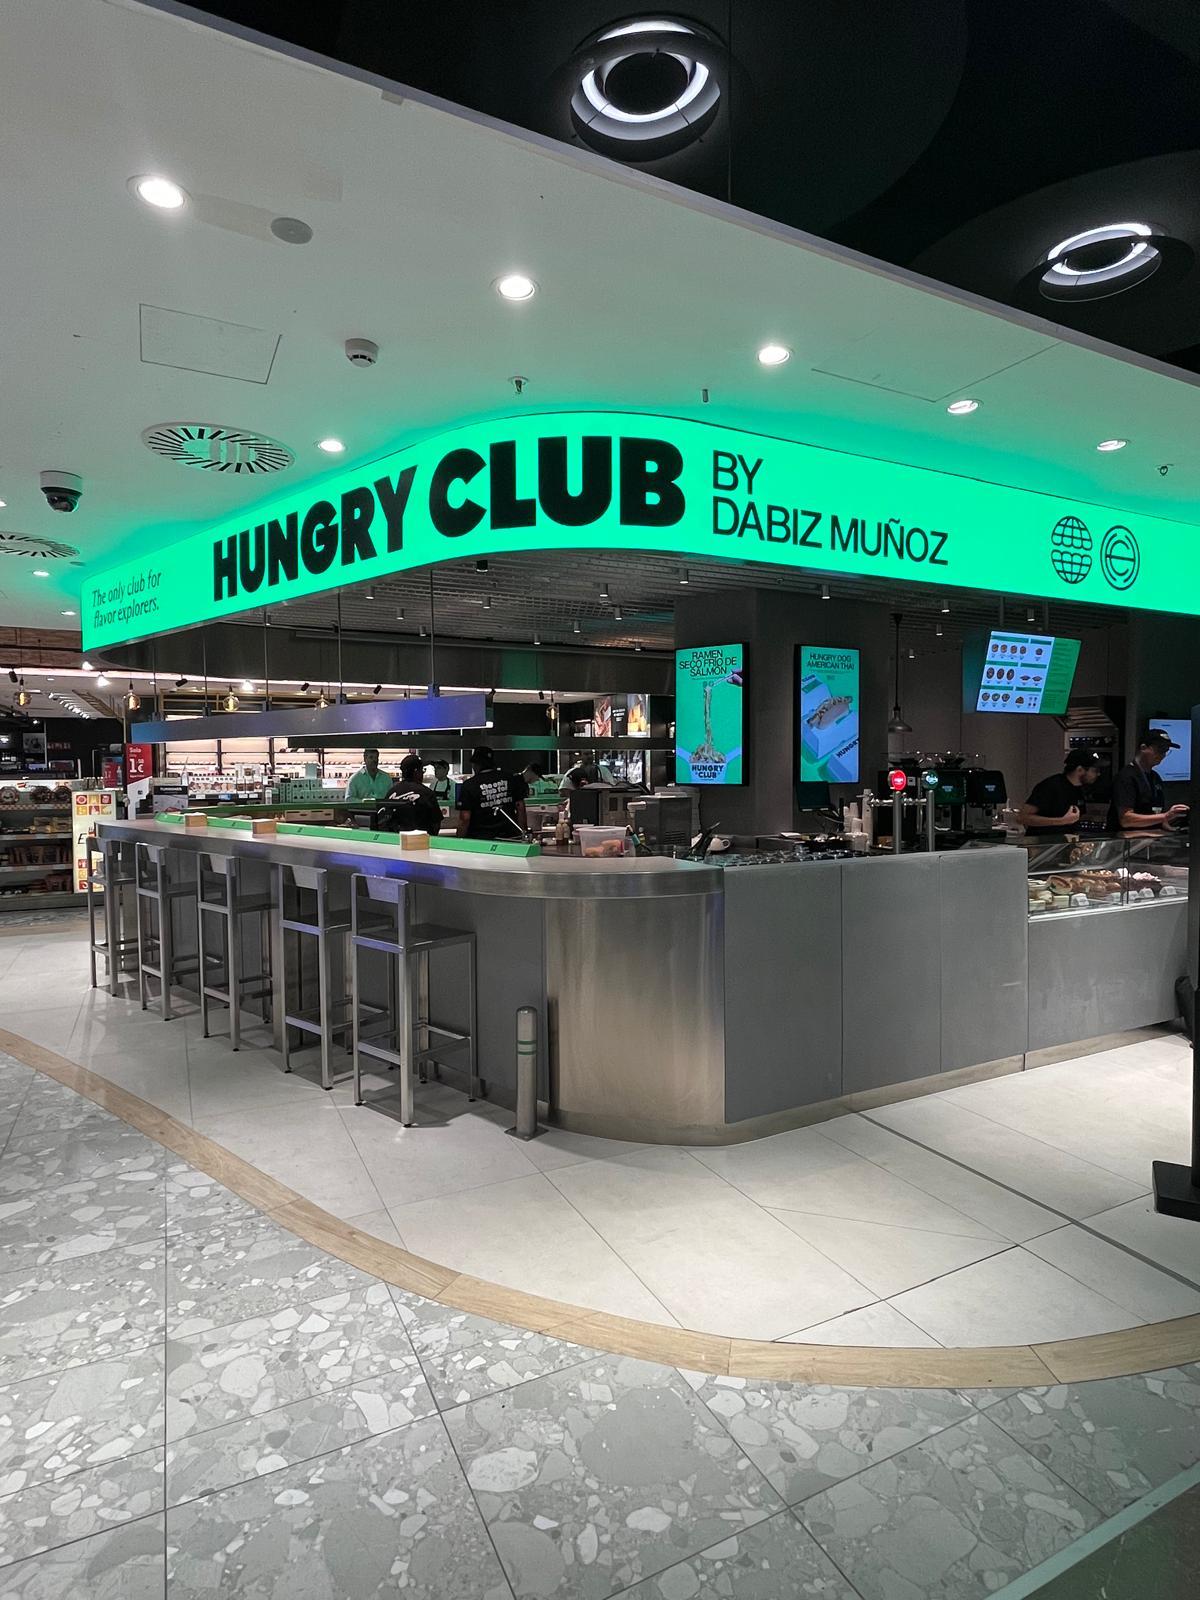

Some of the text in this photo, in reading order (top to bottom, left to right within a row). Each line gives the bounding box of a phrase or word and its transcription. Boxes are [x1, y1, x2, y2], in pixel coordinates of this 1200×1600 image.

[712, 450, 763, 494] BY
[213, 436, 686, 601] HUNGRY CLUB
[712, 496, 949, 566] DABIZ MUÑOZ
[92, 569, 162, 607] The only club for
[94, 597, 160, 628] flavor explorers.
[679, 659, 703, 669] SECO
[725, 656, 737, 666] DE
[692, 650, 723, 660] RAMEN
[810, 653, 836, 662] HUNGRY
[698, 771, 717, 779] CLUB
